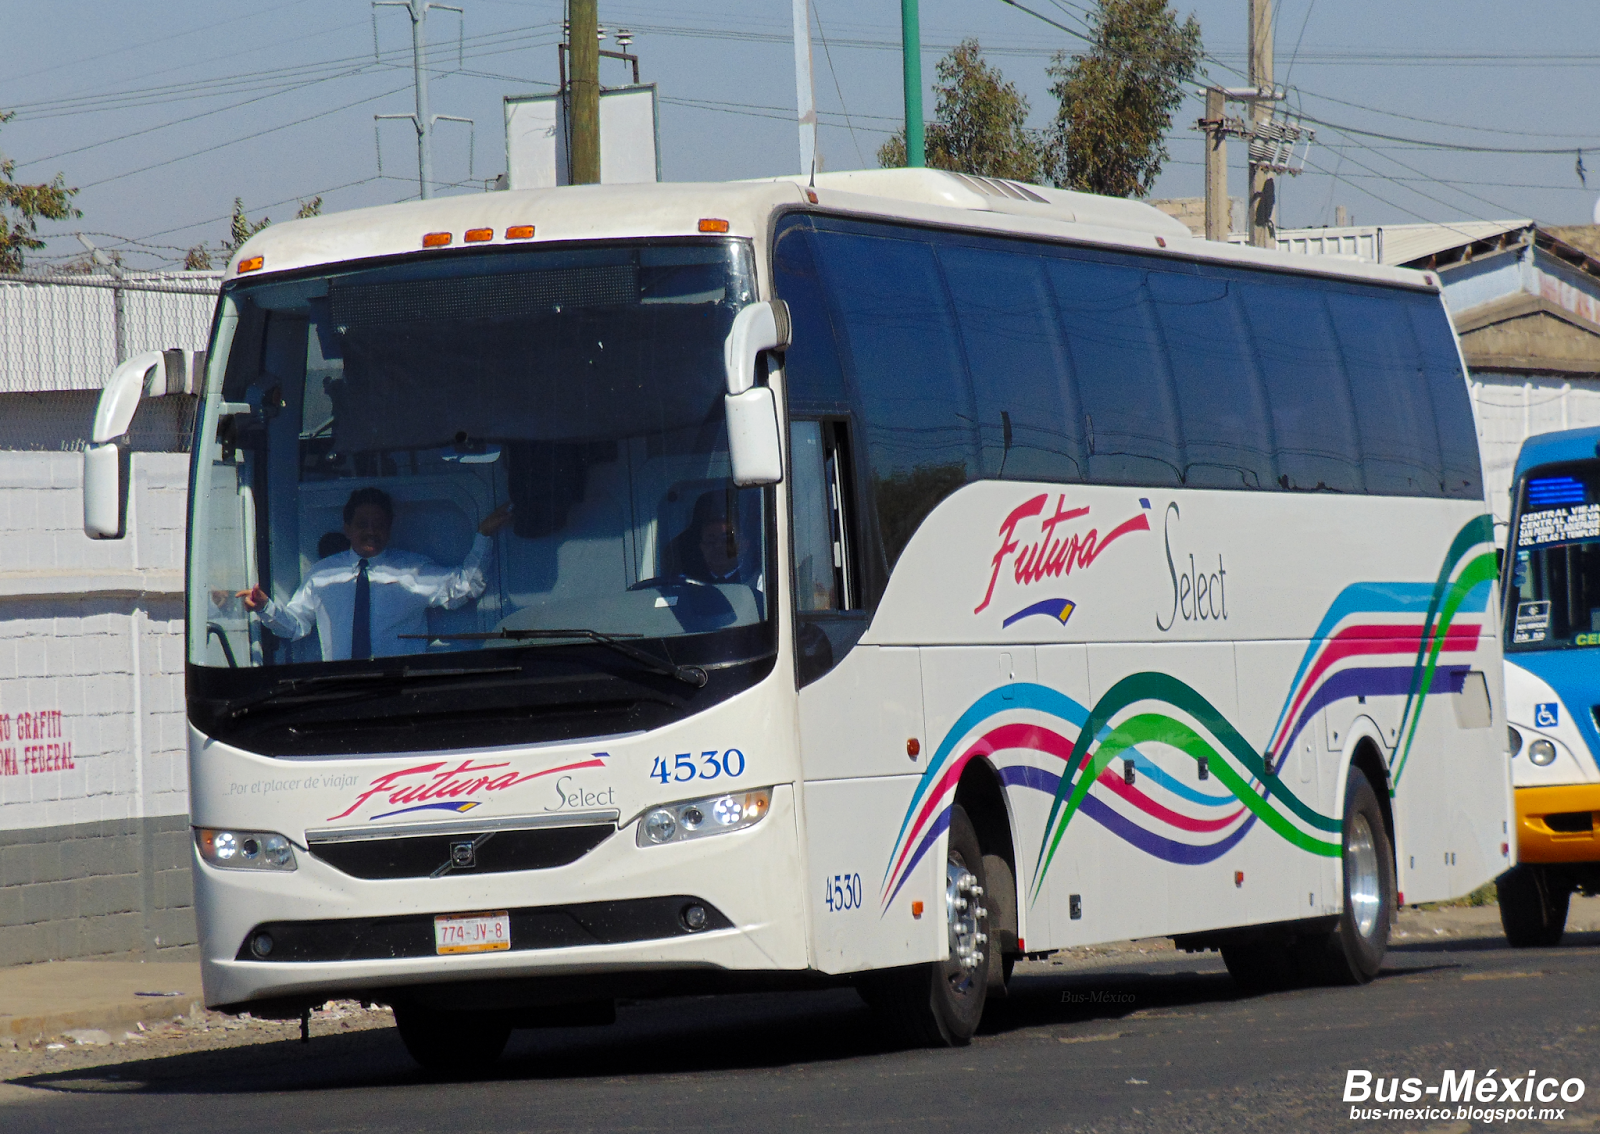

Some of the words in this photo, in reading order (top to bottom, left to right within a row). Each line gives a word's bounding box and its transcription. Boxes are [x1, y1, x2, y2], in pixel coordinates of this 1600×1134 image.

[1519, 517, 1566, 531] CENTRAL
[1566, 512, 1600, 523] NUEVA
[1520, 508, 1569, 523] CENTRAL
[1536, 532, 1560, 544] ATLAS
[974, 493, 1150, 615] Futura
[1156, 501, 1228, 632] Select
[1576, 632, 1600, 646] CE
[16, 710, 62, 741] GRAFITI
[24, 741, 75, 775] FEDERAL
[649, 748, 746, 784] 4530
[250, 780, 261, 794] el
[263, 779, 301, 796] placer
[303, 776, 320, 789] de
[322, 774, 359, 791] viajar
[326, 759, 606, 821] Futura
[544, 775, 615, 811] Select
[825, 872, 862, 912] 4530
